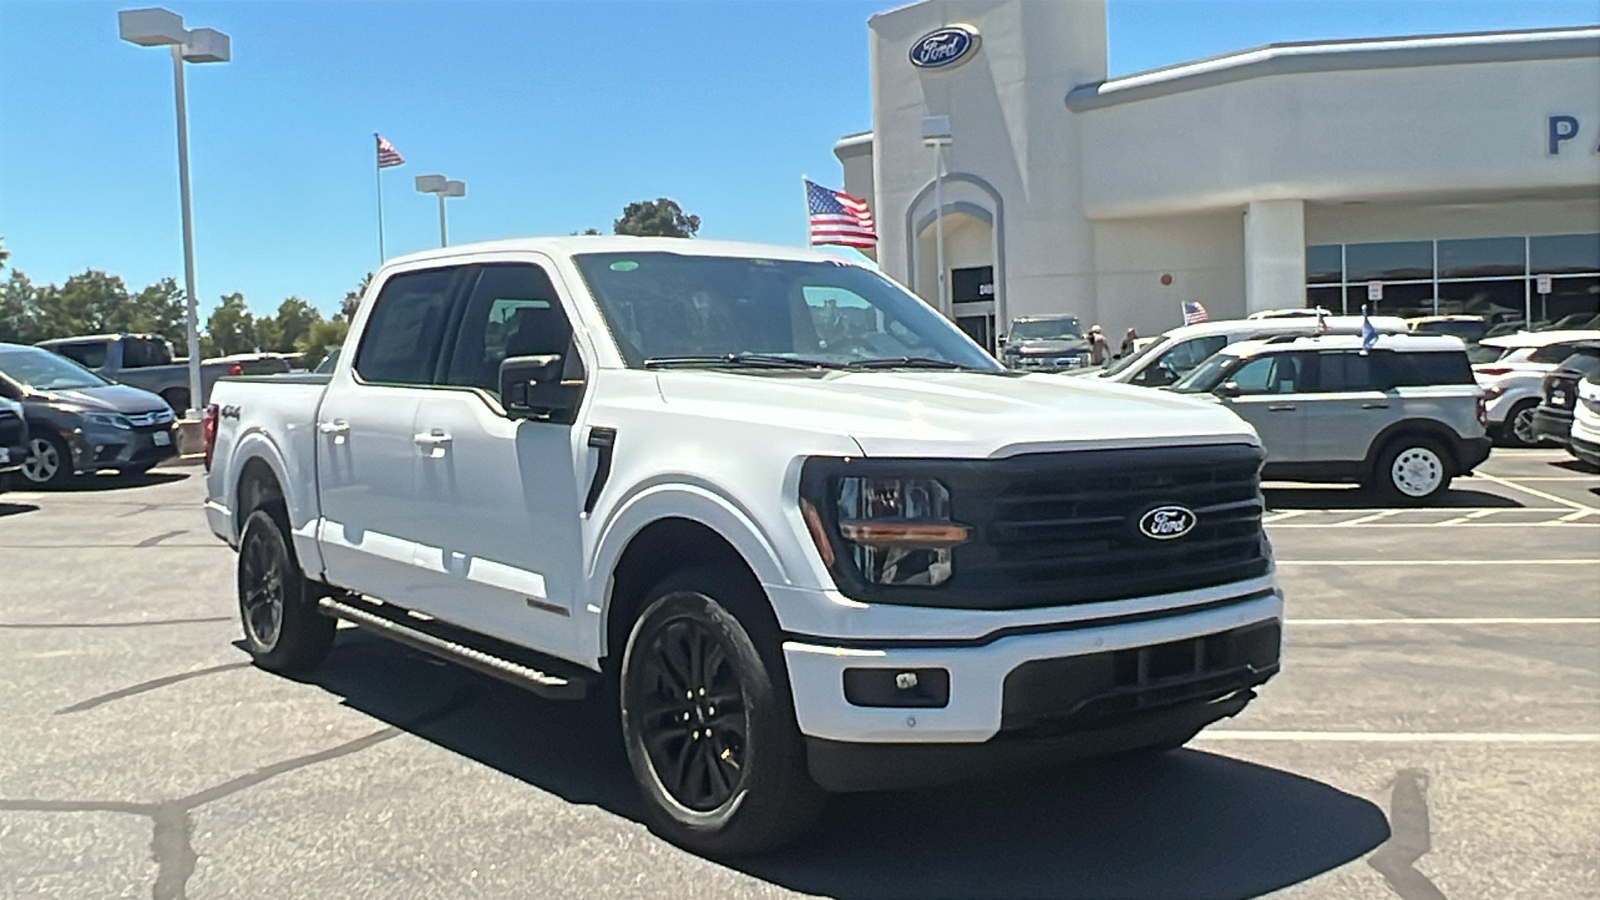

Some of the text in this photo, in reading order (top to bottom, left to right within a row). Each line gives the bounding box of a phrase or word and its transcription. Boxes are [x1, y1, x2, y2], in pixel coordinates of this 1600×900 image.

[920, 34, 959, 62] Ford
[1549, 115, 1600, 155] P
[1150, 510, 1186, 534] Ford
